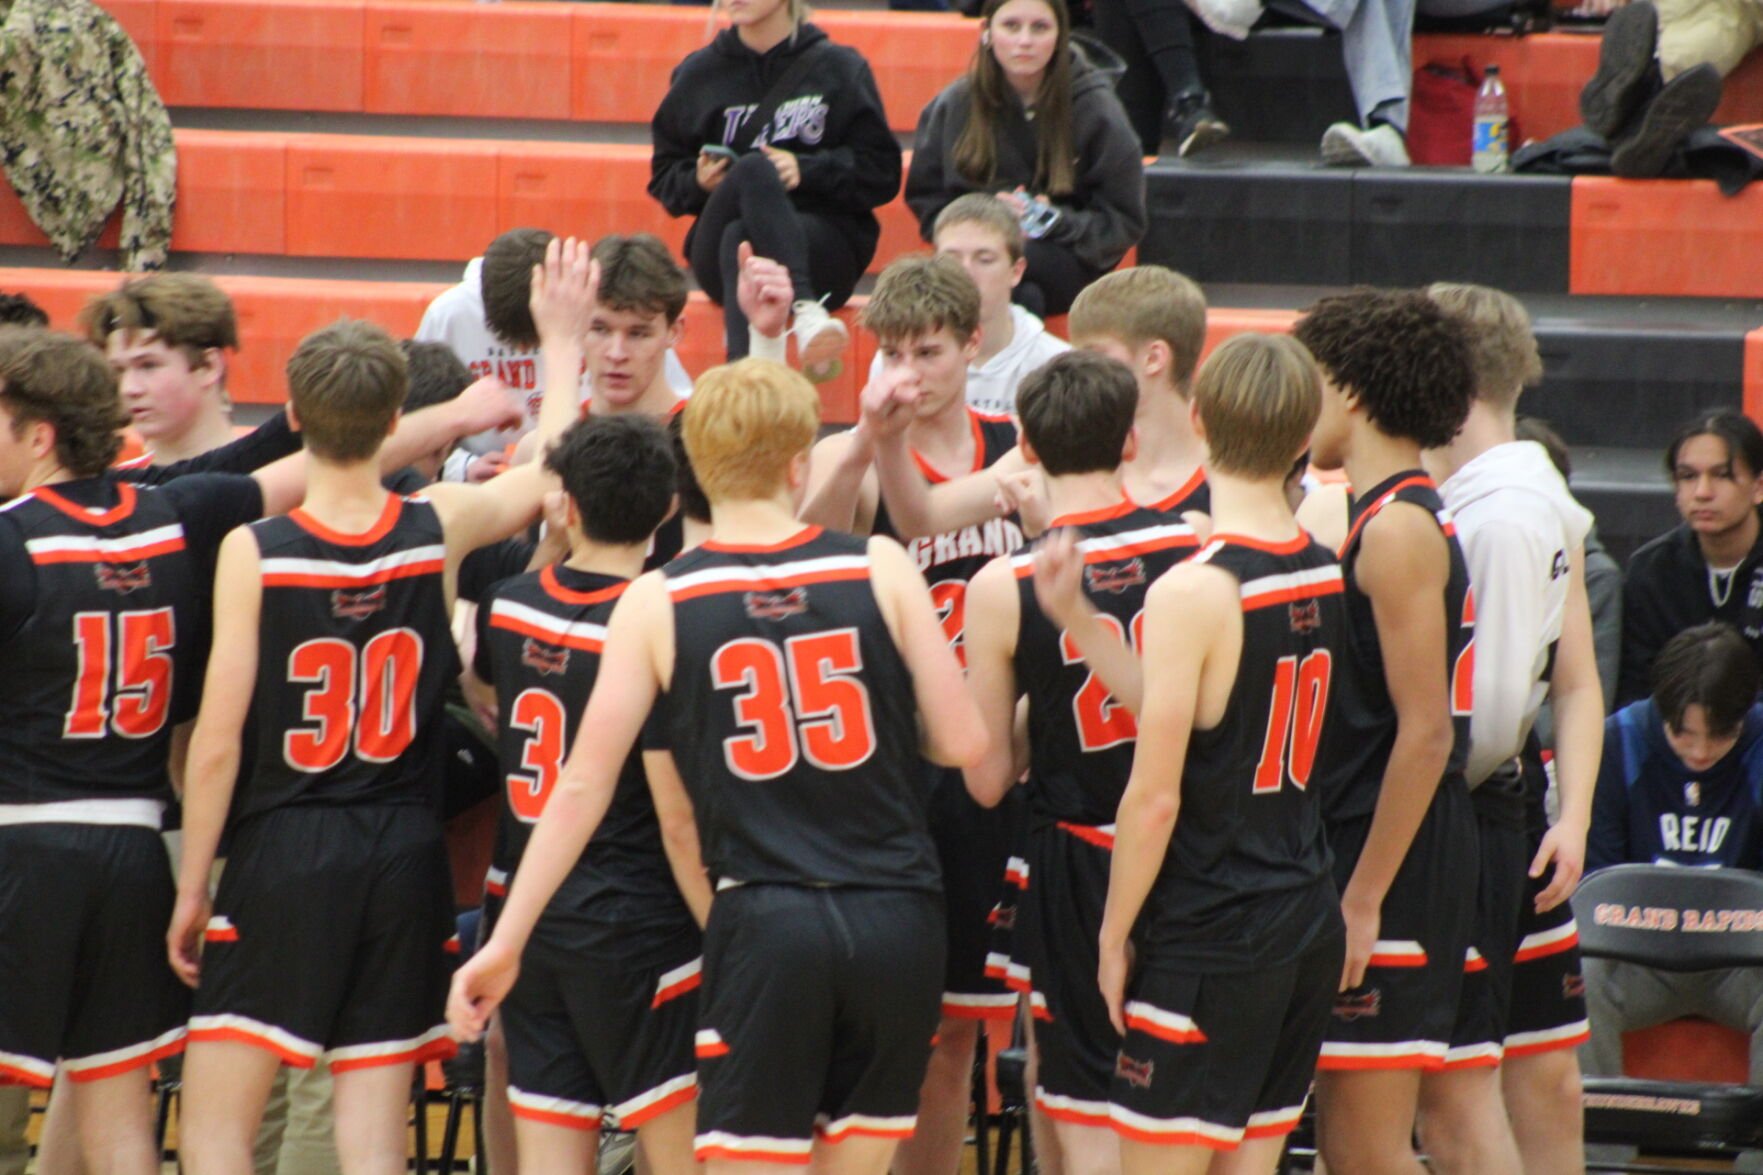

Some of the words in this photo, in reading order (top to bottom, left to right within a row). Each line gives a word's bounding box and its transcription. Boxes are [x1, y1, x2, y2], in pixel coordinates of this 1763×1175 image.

[907, 517, 1024, 573] GRAND
[63, 606, 176, 739] 15
[283, 627, 424, 773] 30
[710, 627, 877, 782] 35
[1059, 609, 1145, 753] 2
[1252, 648, 1332, 795] 10
[505, 687, 567, 824] 3
[1659, 812, 1731, 854] REID
[1594, 902, 1679, 932] GRAND
